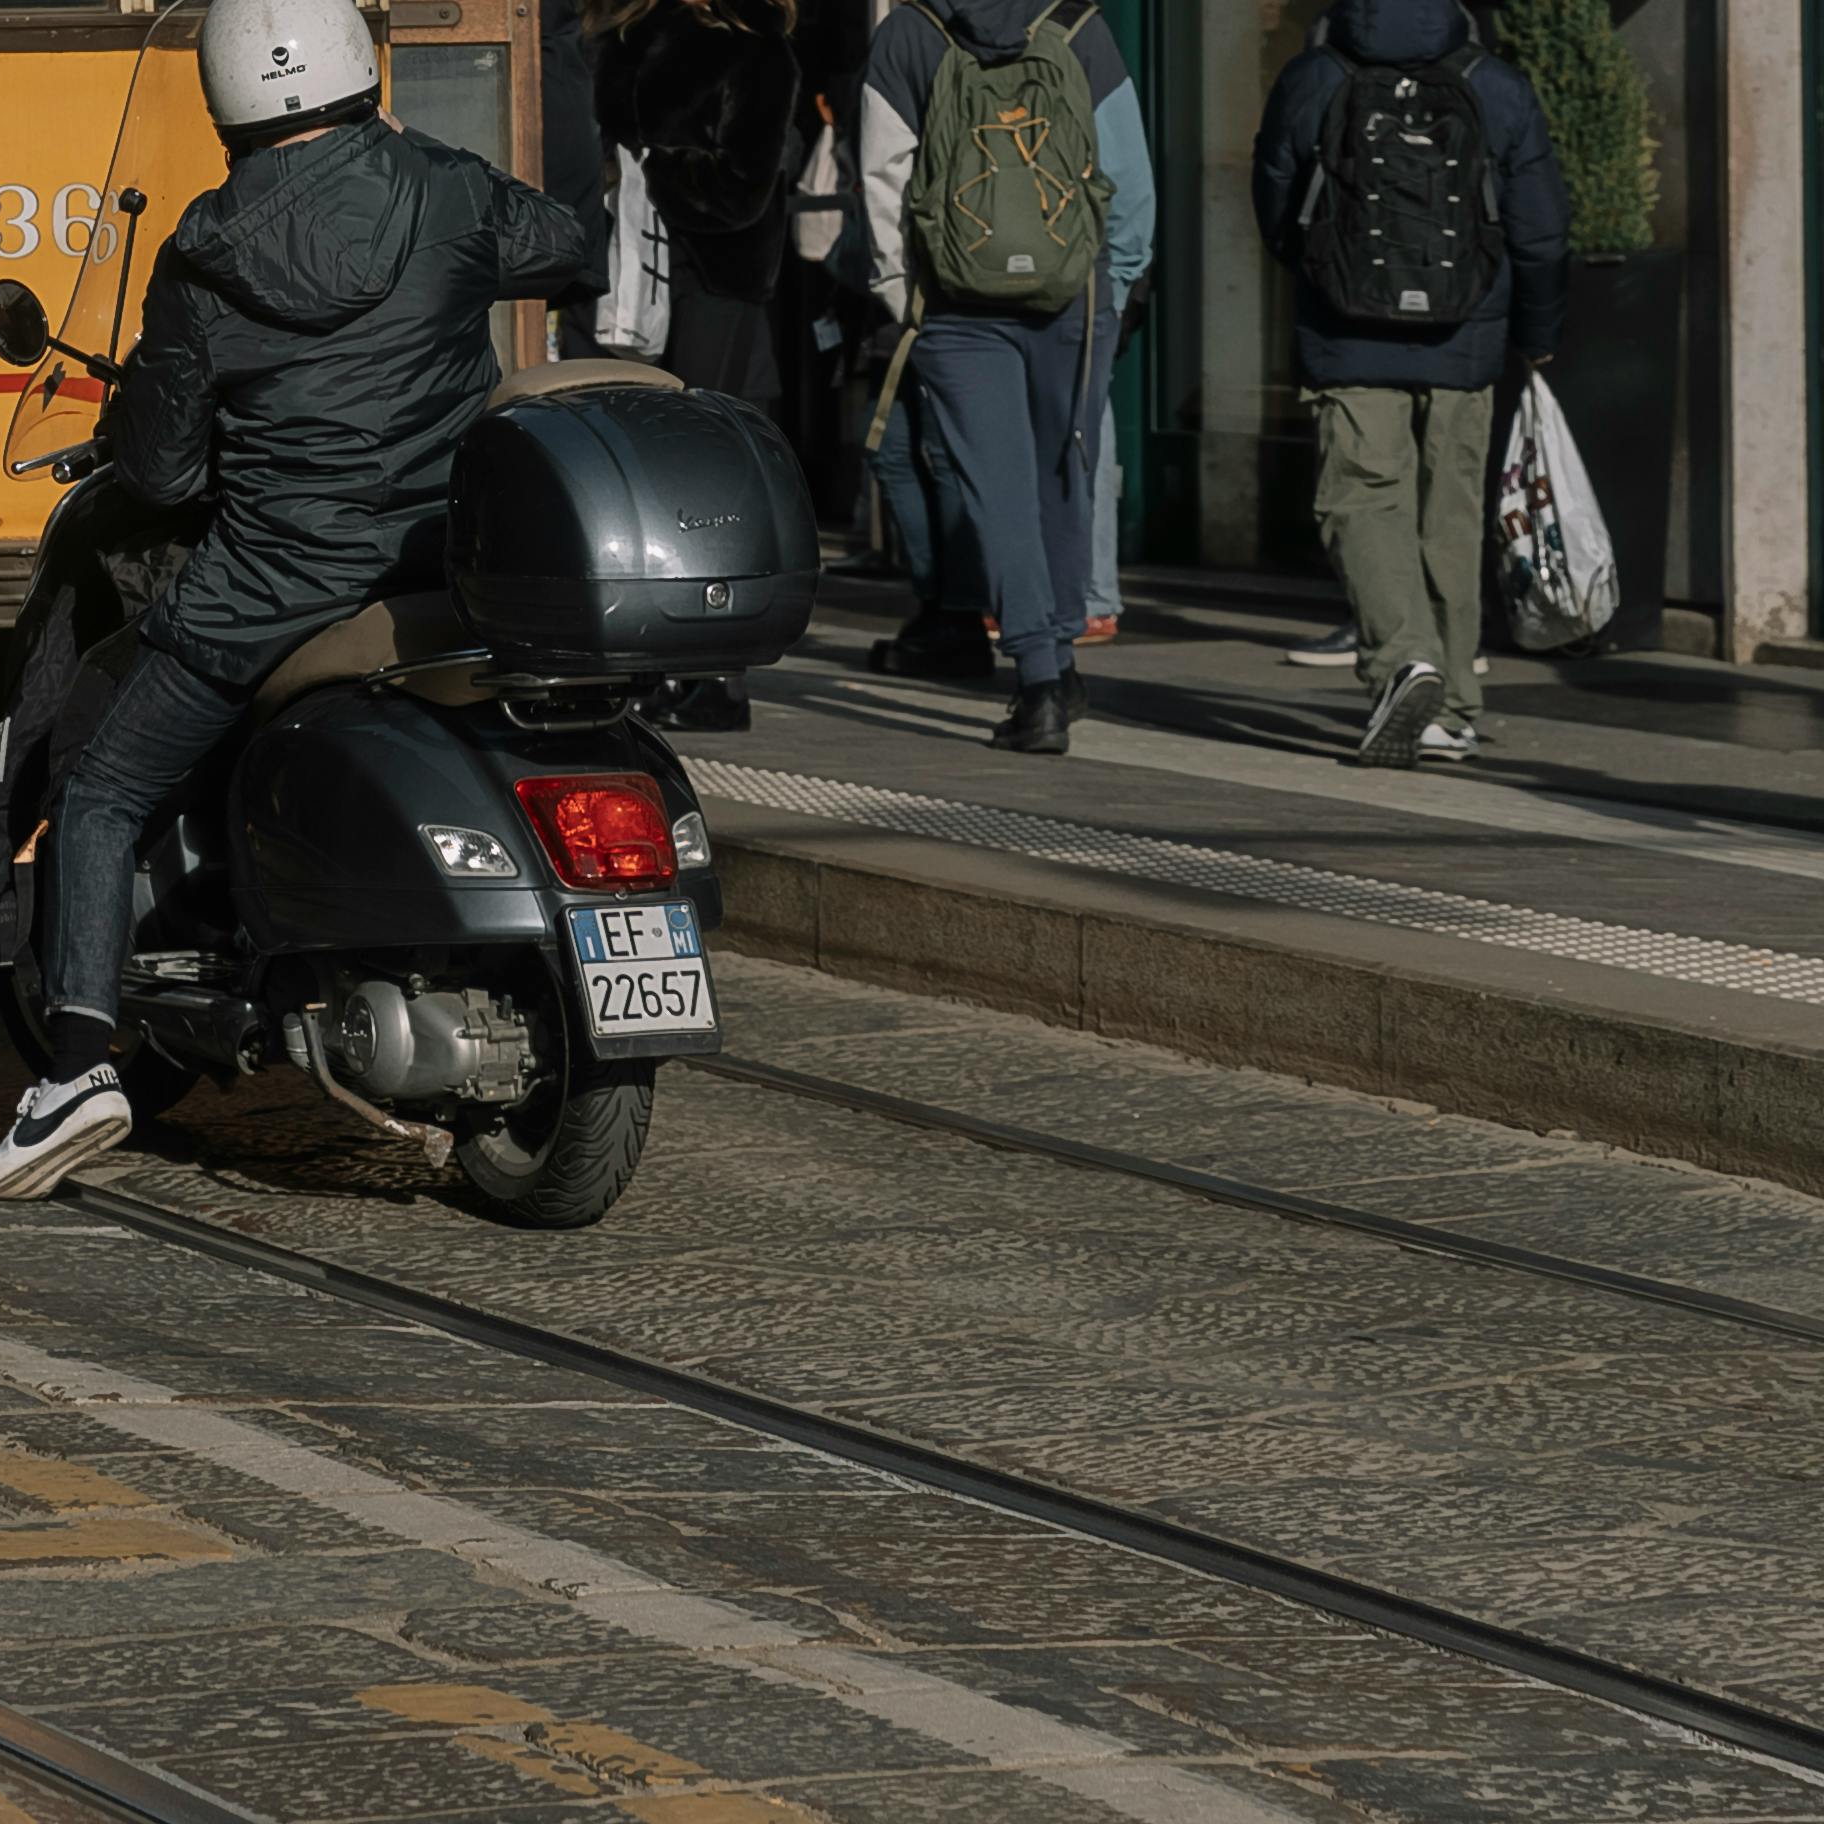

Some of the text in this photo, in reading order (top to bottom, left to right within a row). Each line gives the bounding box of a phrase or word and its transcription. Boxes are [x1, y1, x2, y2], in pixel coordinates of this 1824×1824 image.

[261, 64, 305, 84] HELMO
[585, 911, 695, 958] I EF MI
[592, 970, 700, 1021] 22657
